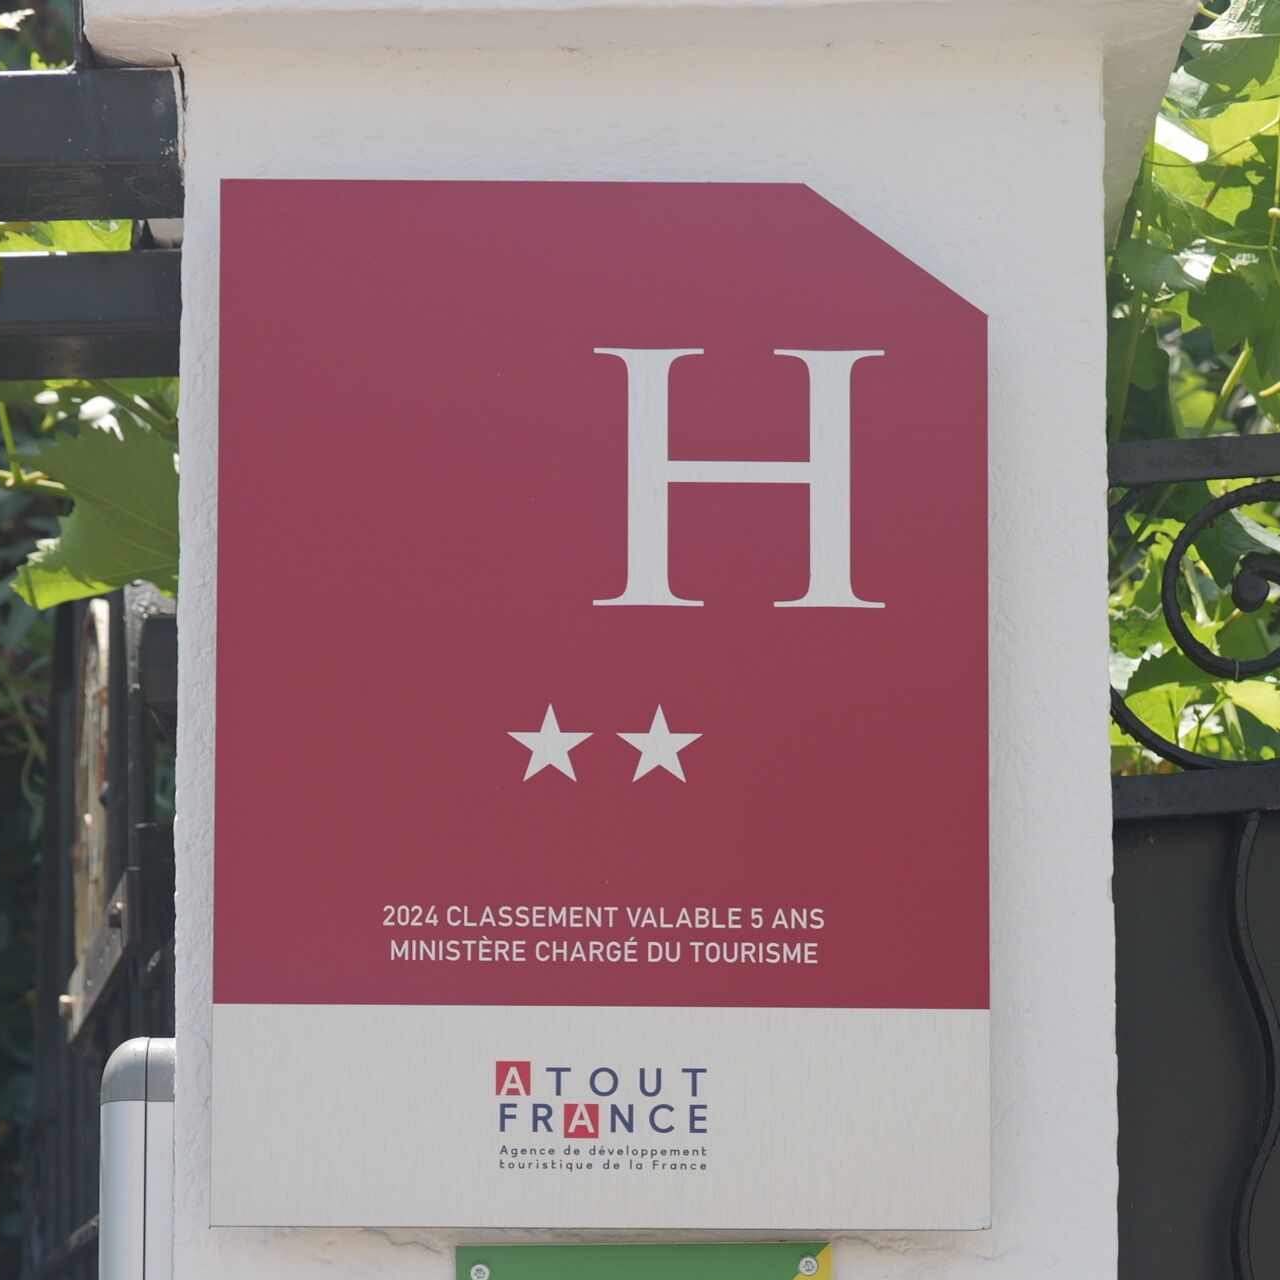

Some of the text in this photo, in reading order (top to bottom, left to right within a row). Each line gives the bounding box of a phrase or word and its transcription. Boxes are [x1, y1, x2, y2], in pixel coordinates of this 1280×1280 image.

[592, 347, 886, 609] H
[382, 905, 825, 930] 2024 CLASSEMENT VALABLE 5 ANS
[389, 936, 819, 965] MINISTÈRE CHARGÉ DU TOURISME
[498, 1065, 708, 1098] ATOUT
[499, 1103, 708, 1134] FRANCE
[499, 1145, 708, 1159] Agence de développement
[499, 1159, 708, 1171] touristique de la France
